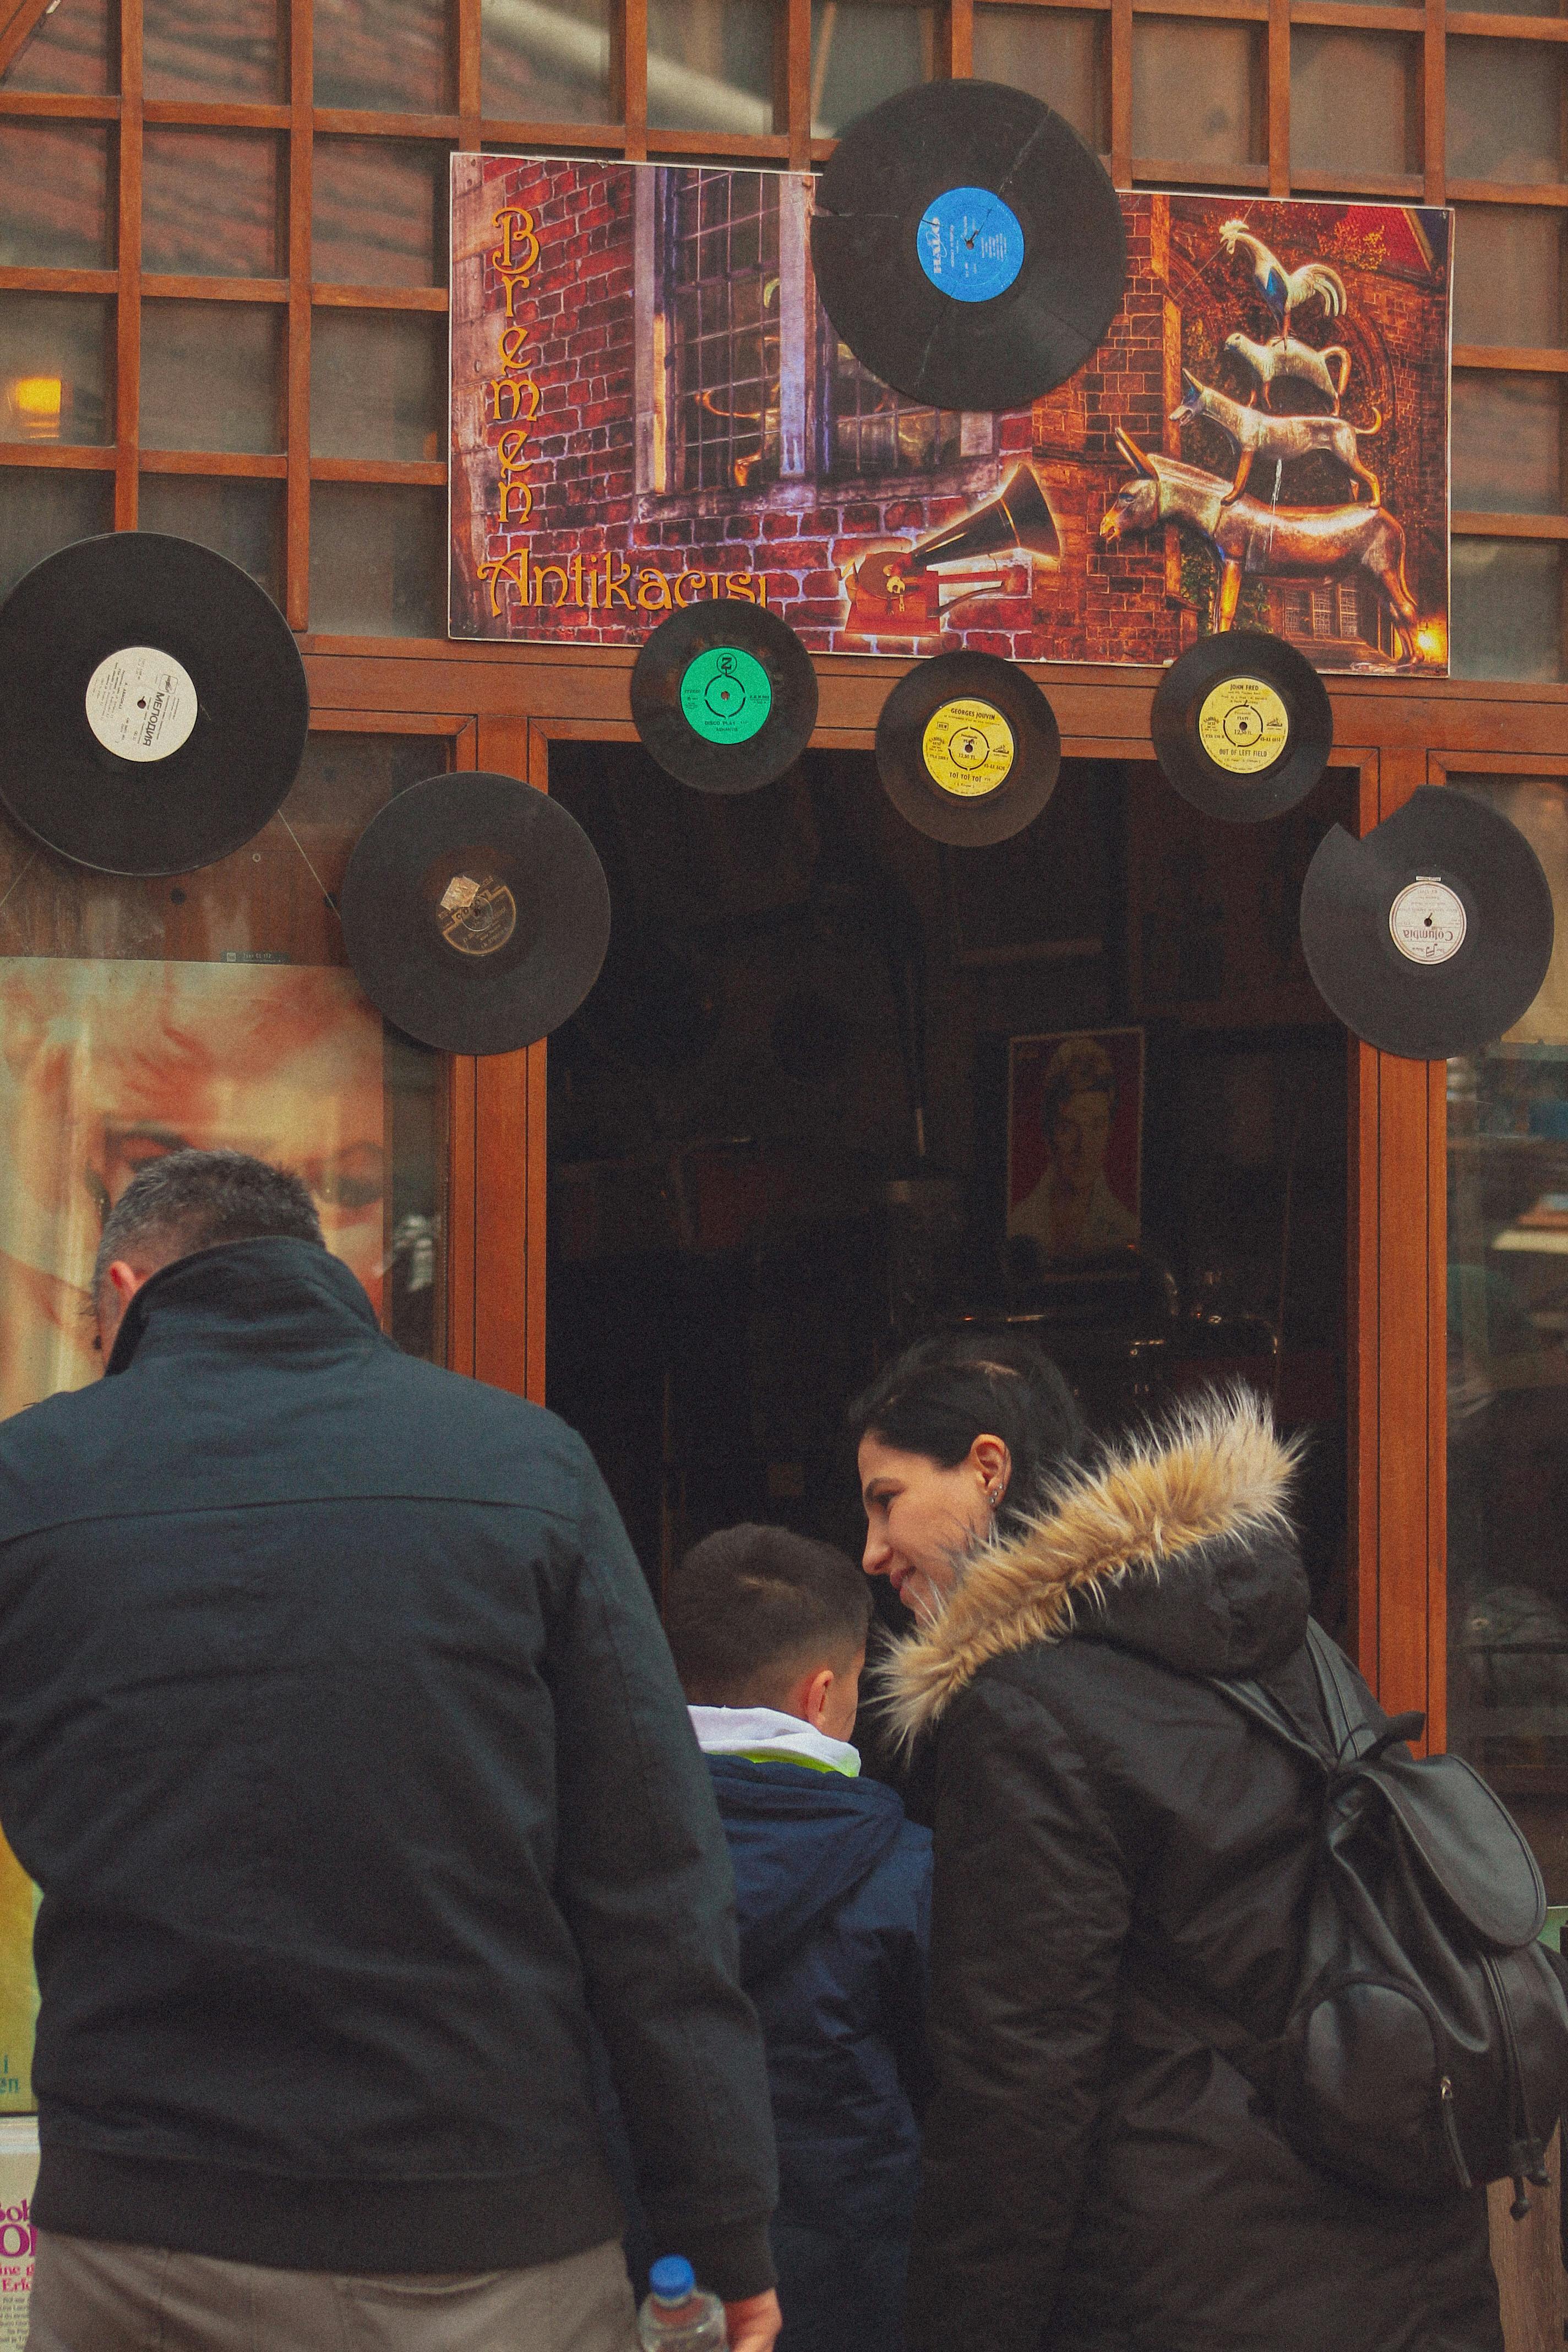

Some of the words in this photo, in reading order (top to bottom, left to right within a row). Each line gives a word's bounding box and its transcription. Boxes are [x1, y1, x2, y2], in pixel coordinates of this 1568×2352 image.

[492, 206, 541, 524] Bremen
[143, 692, 165, 747] МЕЛОДИЯ
[951, 708, 974, 717] GEORGES
[976, 712, 995, 721] JOUVIN
[1403, 928, 1453, 941] Columbia
